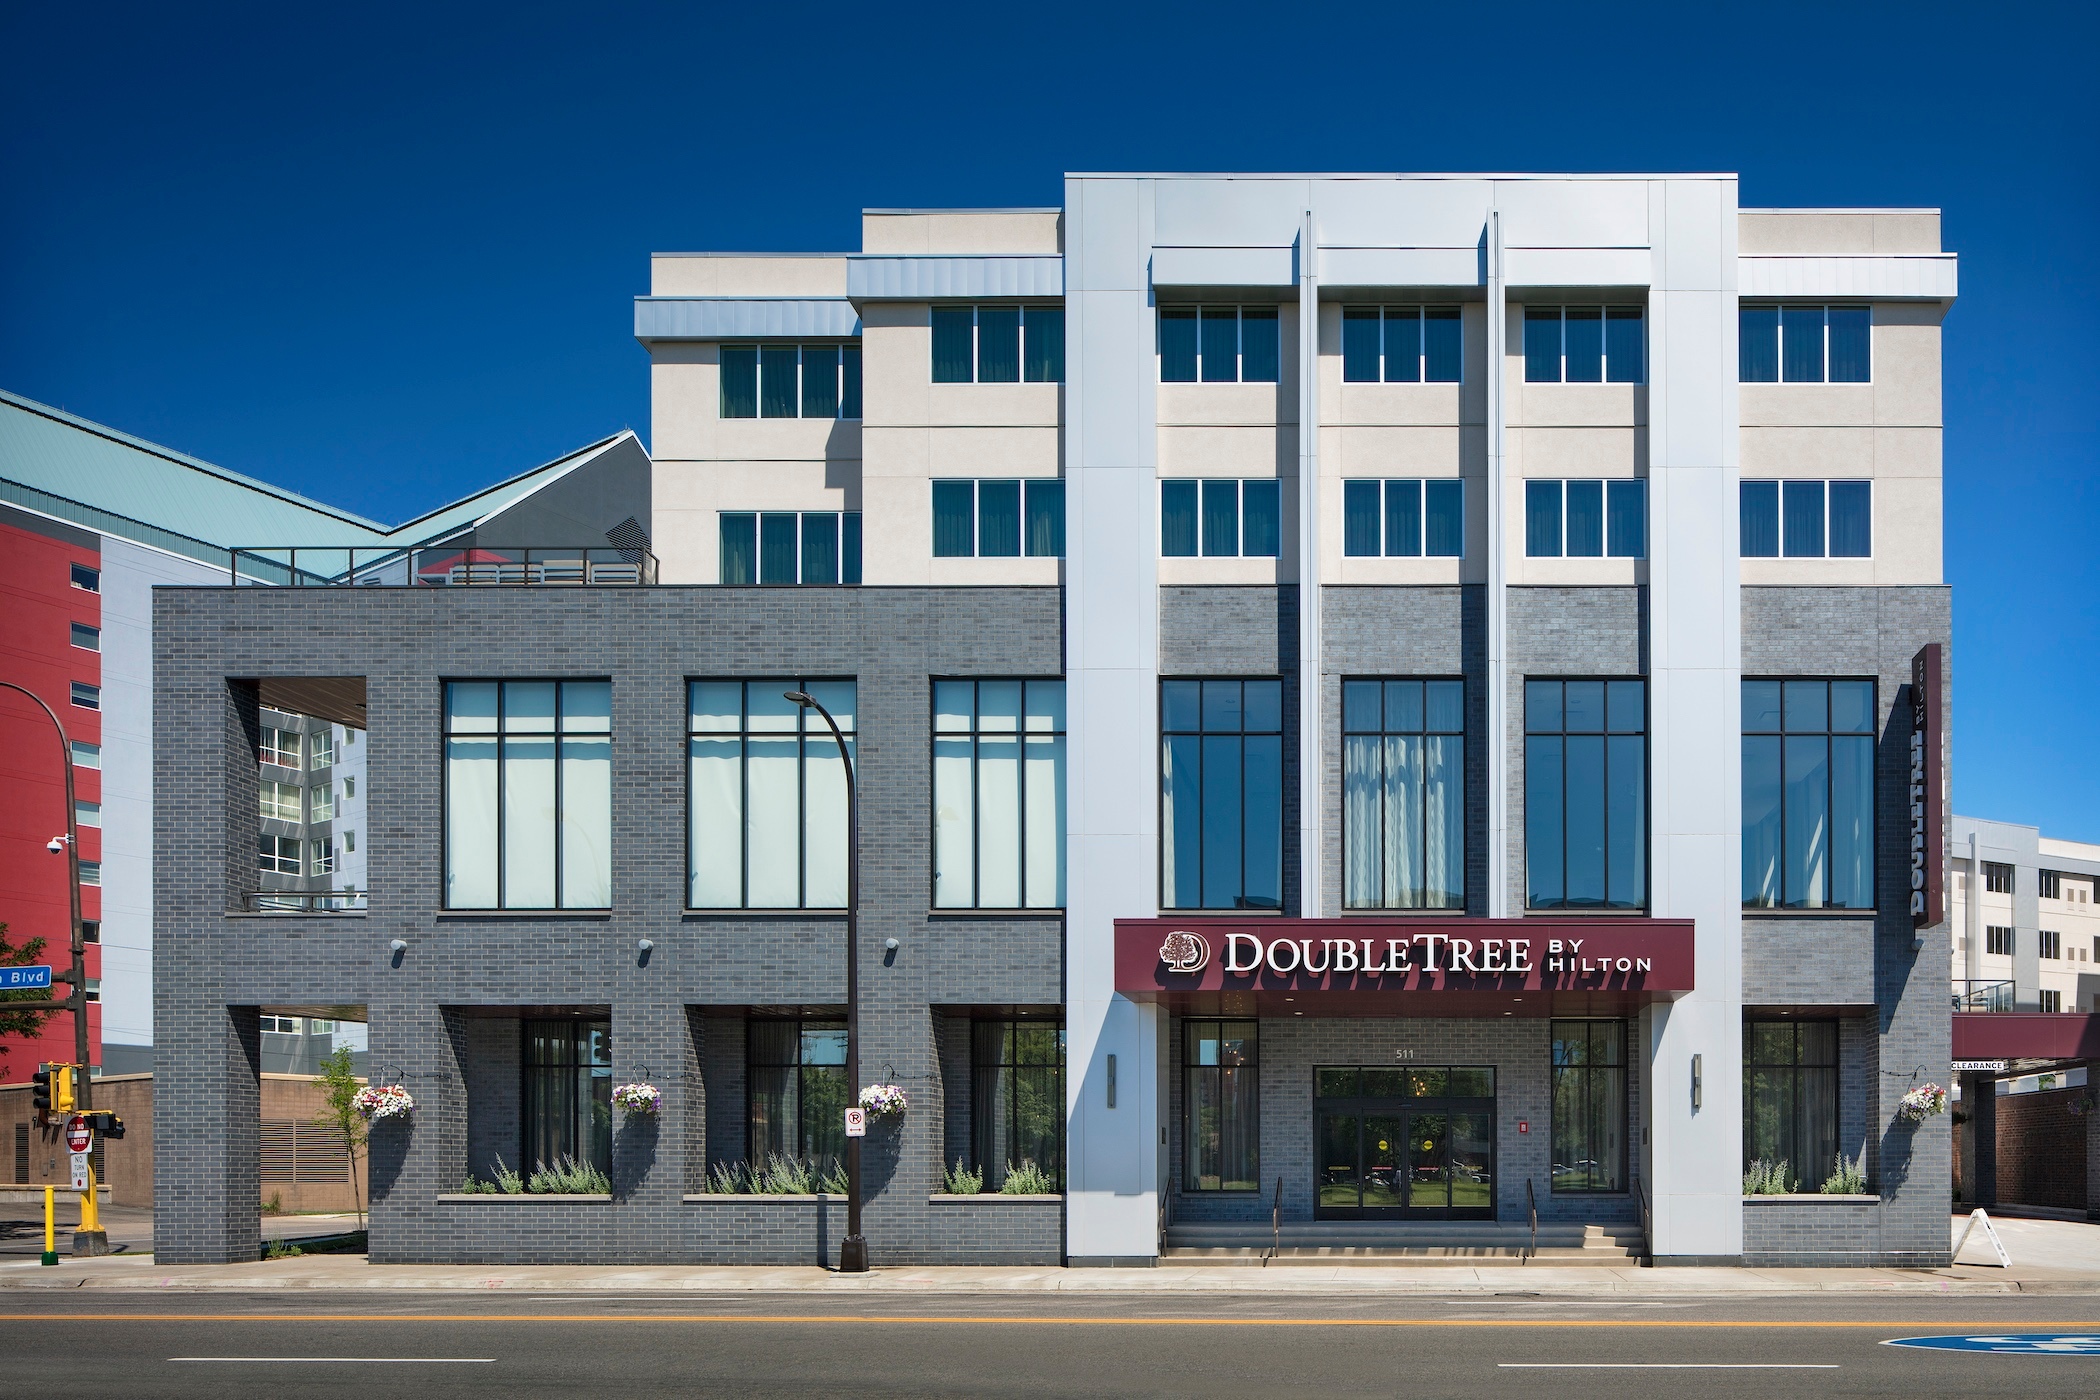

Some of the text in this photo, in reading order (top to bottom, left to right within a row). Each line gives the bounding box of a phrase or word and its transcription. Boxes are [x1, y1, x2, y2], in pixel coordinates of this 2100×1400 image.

[1549, 939, 1584, 953] BY
[1225, 933, 1533, 972] DOUBLETREE
[1549, 957, 1651, 972] HILTON
[11, 971, 44, 983] Blvd
[1396, 1049, 1414, 1059] 511
[68, 1123, 76, 1131] DO
[71, 1137, 86, 1146] ENTER
[74, 1155, 82, 1163] NO
